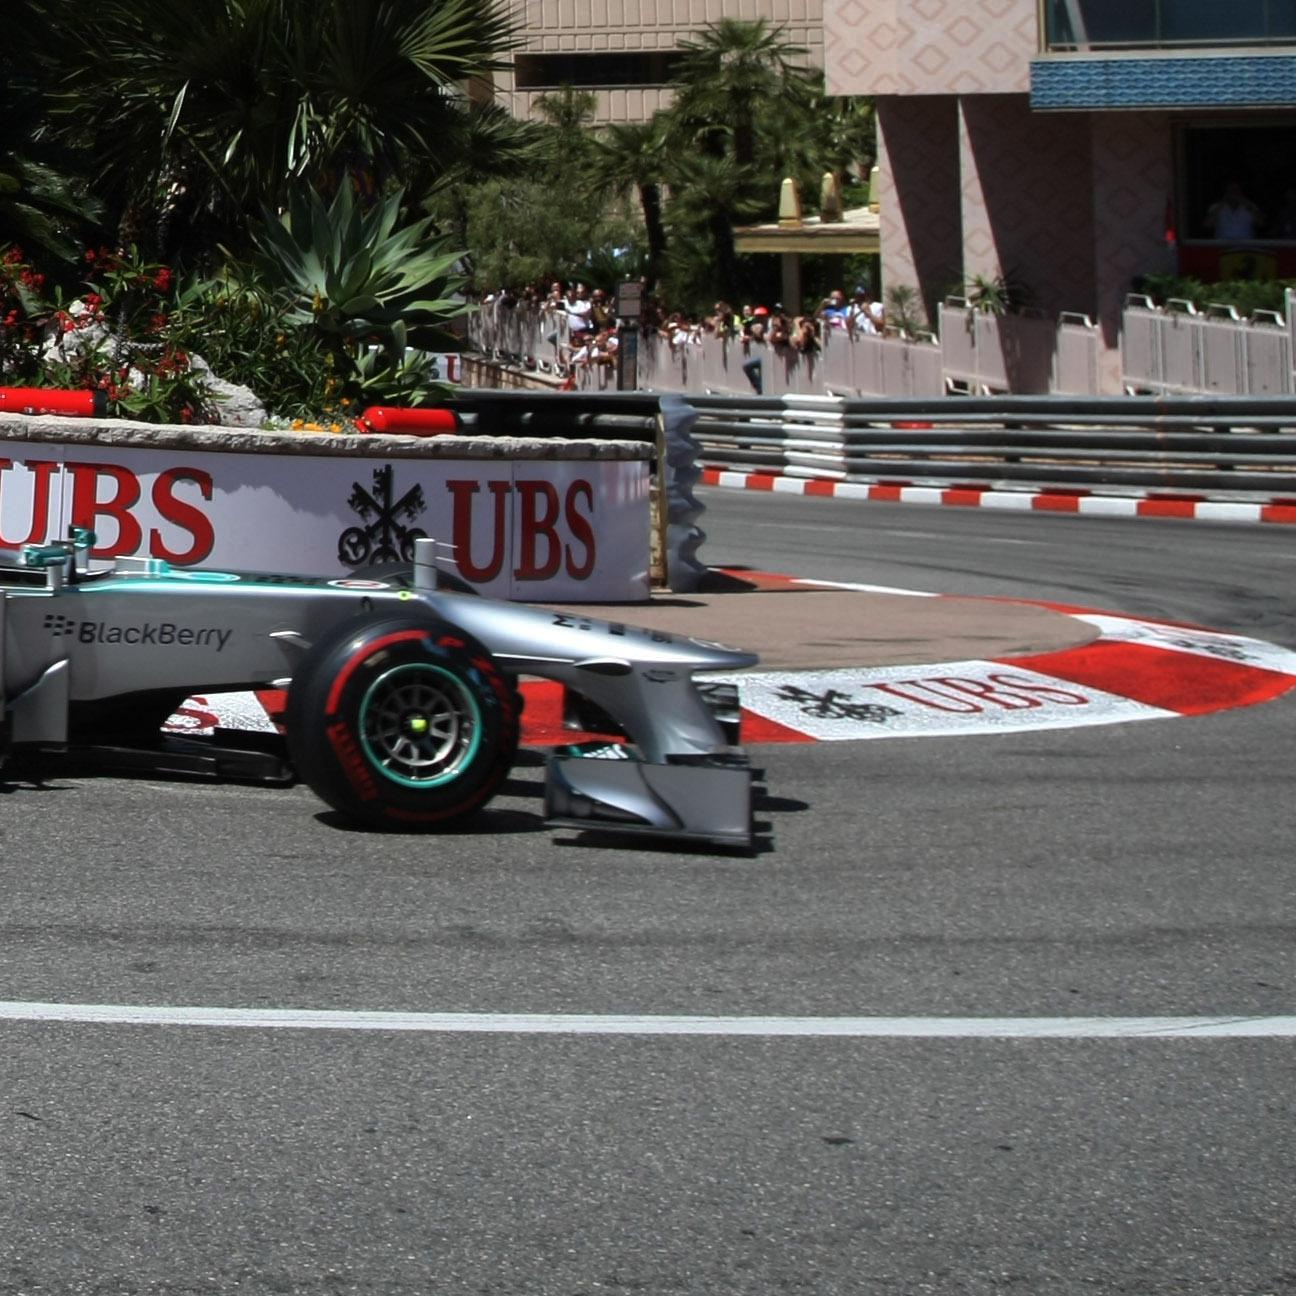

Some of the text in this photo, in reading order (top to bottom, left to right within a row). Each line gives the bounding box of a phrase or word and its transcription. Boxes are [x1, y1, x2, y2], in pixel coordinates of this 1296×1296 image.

[446, 479, 595, 583] UBS
[78, 621, 232, 652] BlackBerry
[862, 674, 1089, 714] UBS
